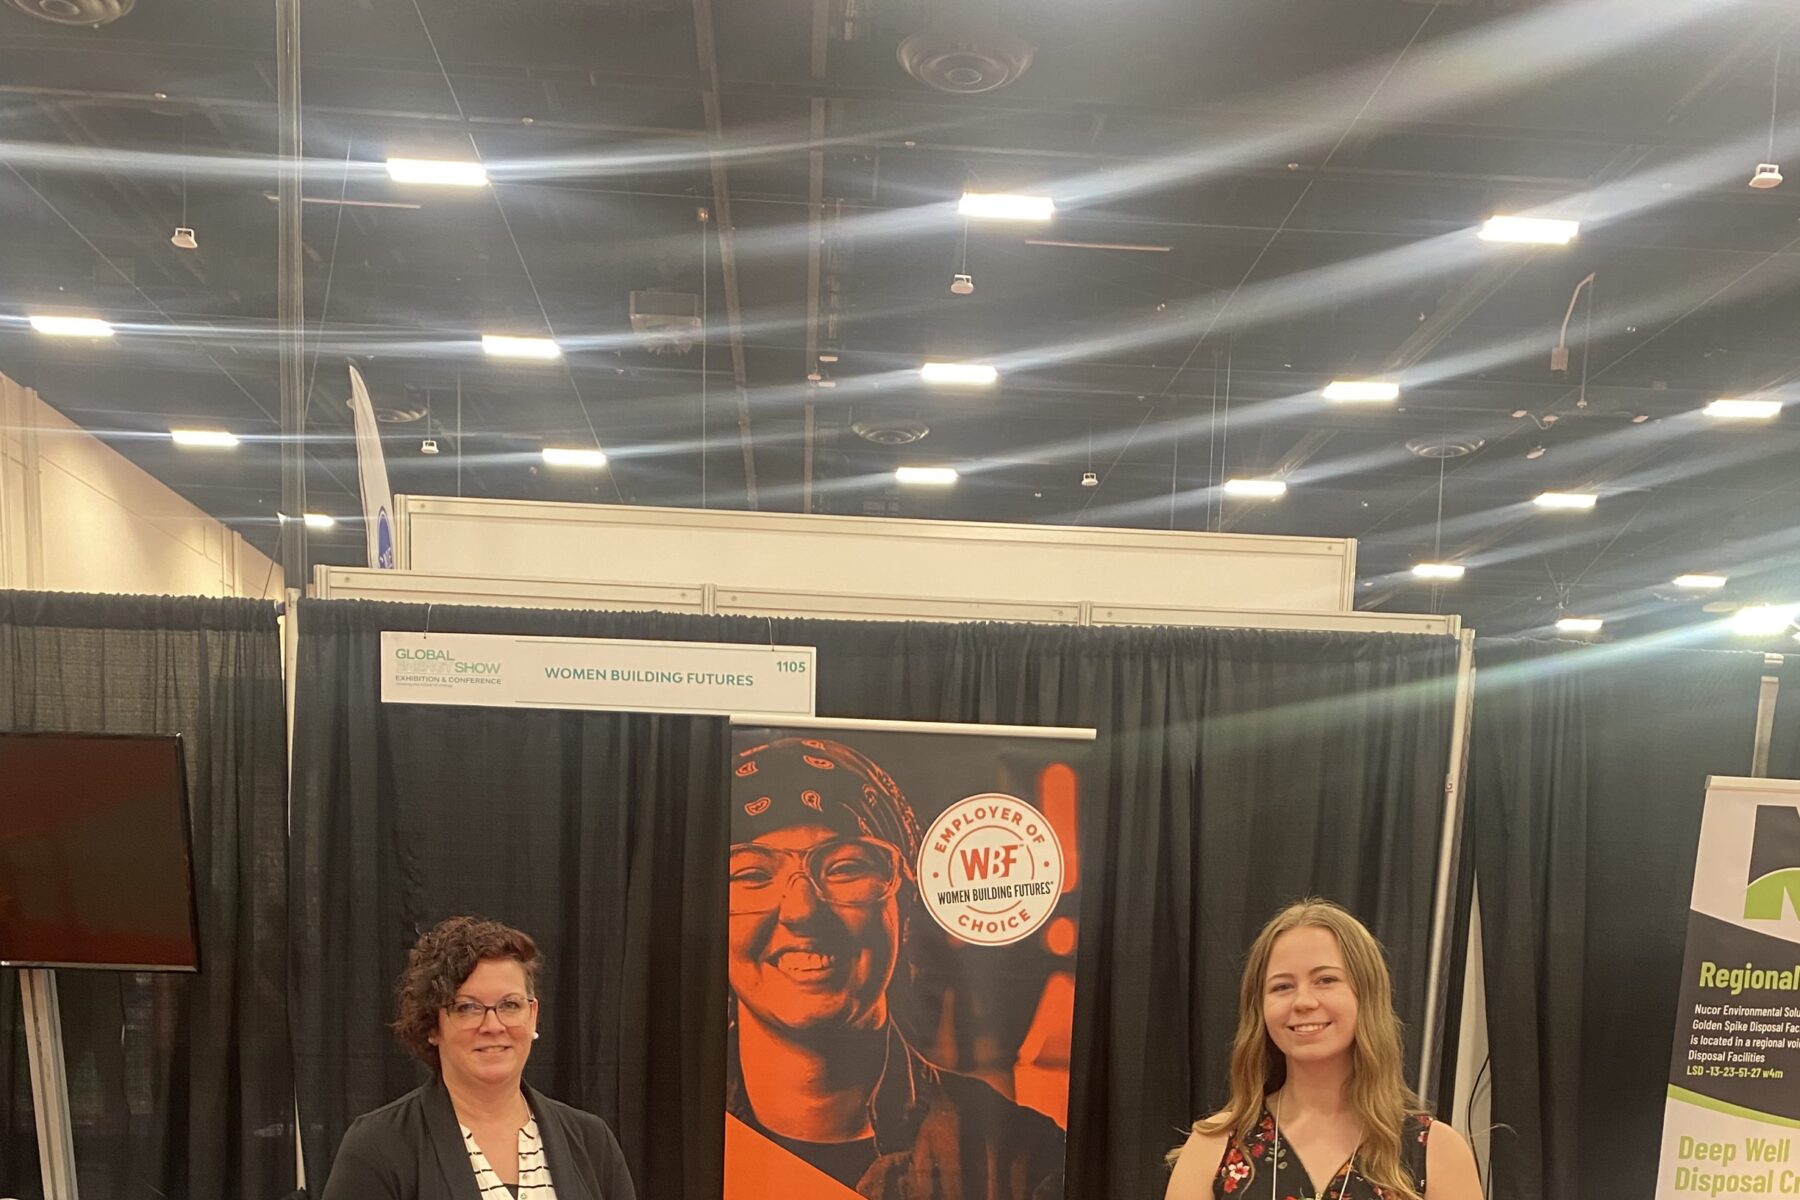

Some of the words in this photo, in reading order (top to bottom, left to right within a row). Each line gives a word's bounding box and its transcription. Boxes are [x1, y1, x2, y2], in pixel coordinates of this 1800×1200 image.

[395, 648, 456, 661] GLOBAL
[455, 662, 501, 674] SHOW
[776, 661, 806, 673] 1105
[395, 675, 440, 683] EXHIBITION
[448, 677, 502, 685] CONFERENCE
[545, 667, 607, 681] WOMEN
[611, 670, 683, 684] BUILDING
[687, 673, 754, 687] FUTURES
[934, 806, 1023, 854] EMPLOYER
[1026, 824, 1045, 844] OF
[960, 844, 1019, 881] WBF
[937, 890, 970, 905] WOMEN
[972, 885, 1012, 902] BUILDING
[958, 908, 1031, 933] CHOICE
[1699, 961, 1800, 996] Regional
[1695, 1004, 1721, 1015] Nucor
[1723, 1005, 1782, 1017] Environmental
[1693, 1019, 1722, 1031] Golden
[1724, 1020, 1748, 1033] Spike
[1749, 1021, 1784, 1034] Disposal
[1785, 1023, 1800, 1033] Fac
[1690, 1034, 1698, 1045] is
[1700, 1035, 1733, 1046] located
[1735, 1036, 1743, 1047] in
[1745, 1039, 1750, 1047] a
[1752, 1037, 1785, 1050] regional
[1688, 1050, 1726, 1062] Disposal
[1728, 1052, 1766, 1063] Facilities
[1687, 1065, 1704, 1076] LSD
[1763, 1068, 1784, 1079] w4m
[1678, 1136, 1737, 1167] Deep
[1745, 1138, 1791, 1163] Well
[1674, 1166, 1774, 1198] Disposal
